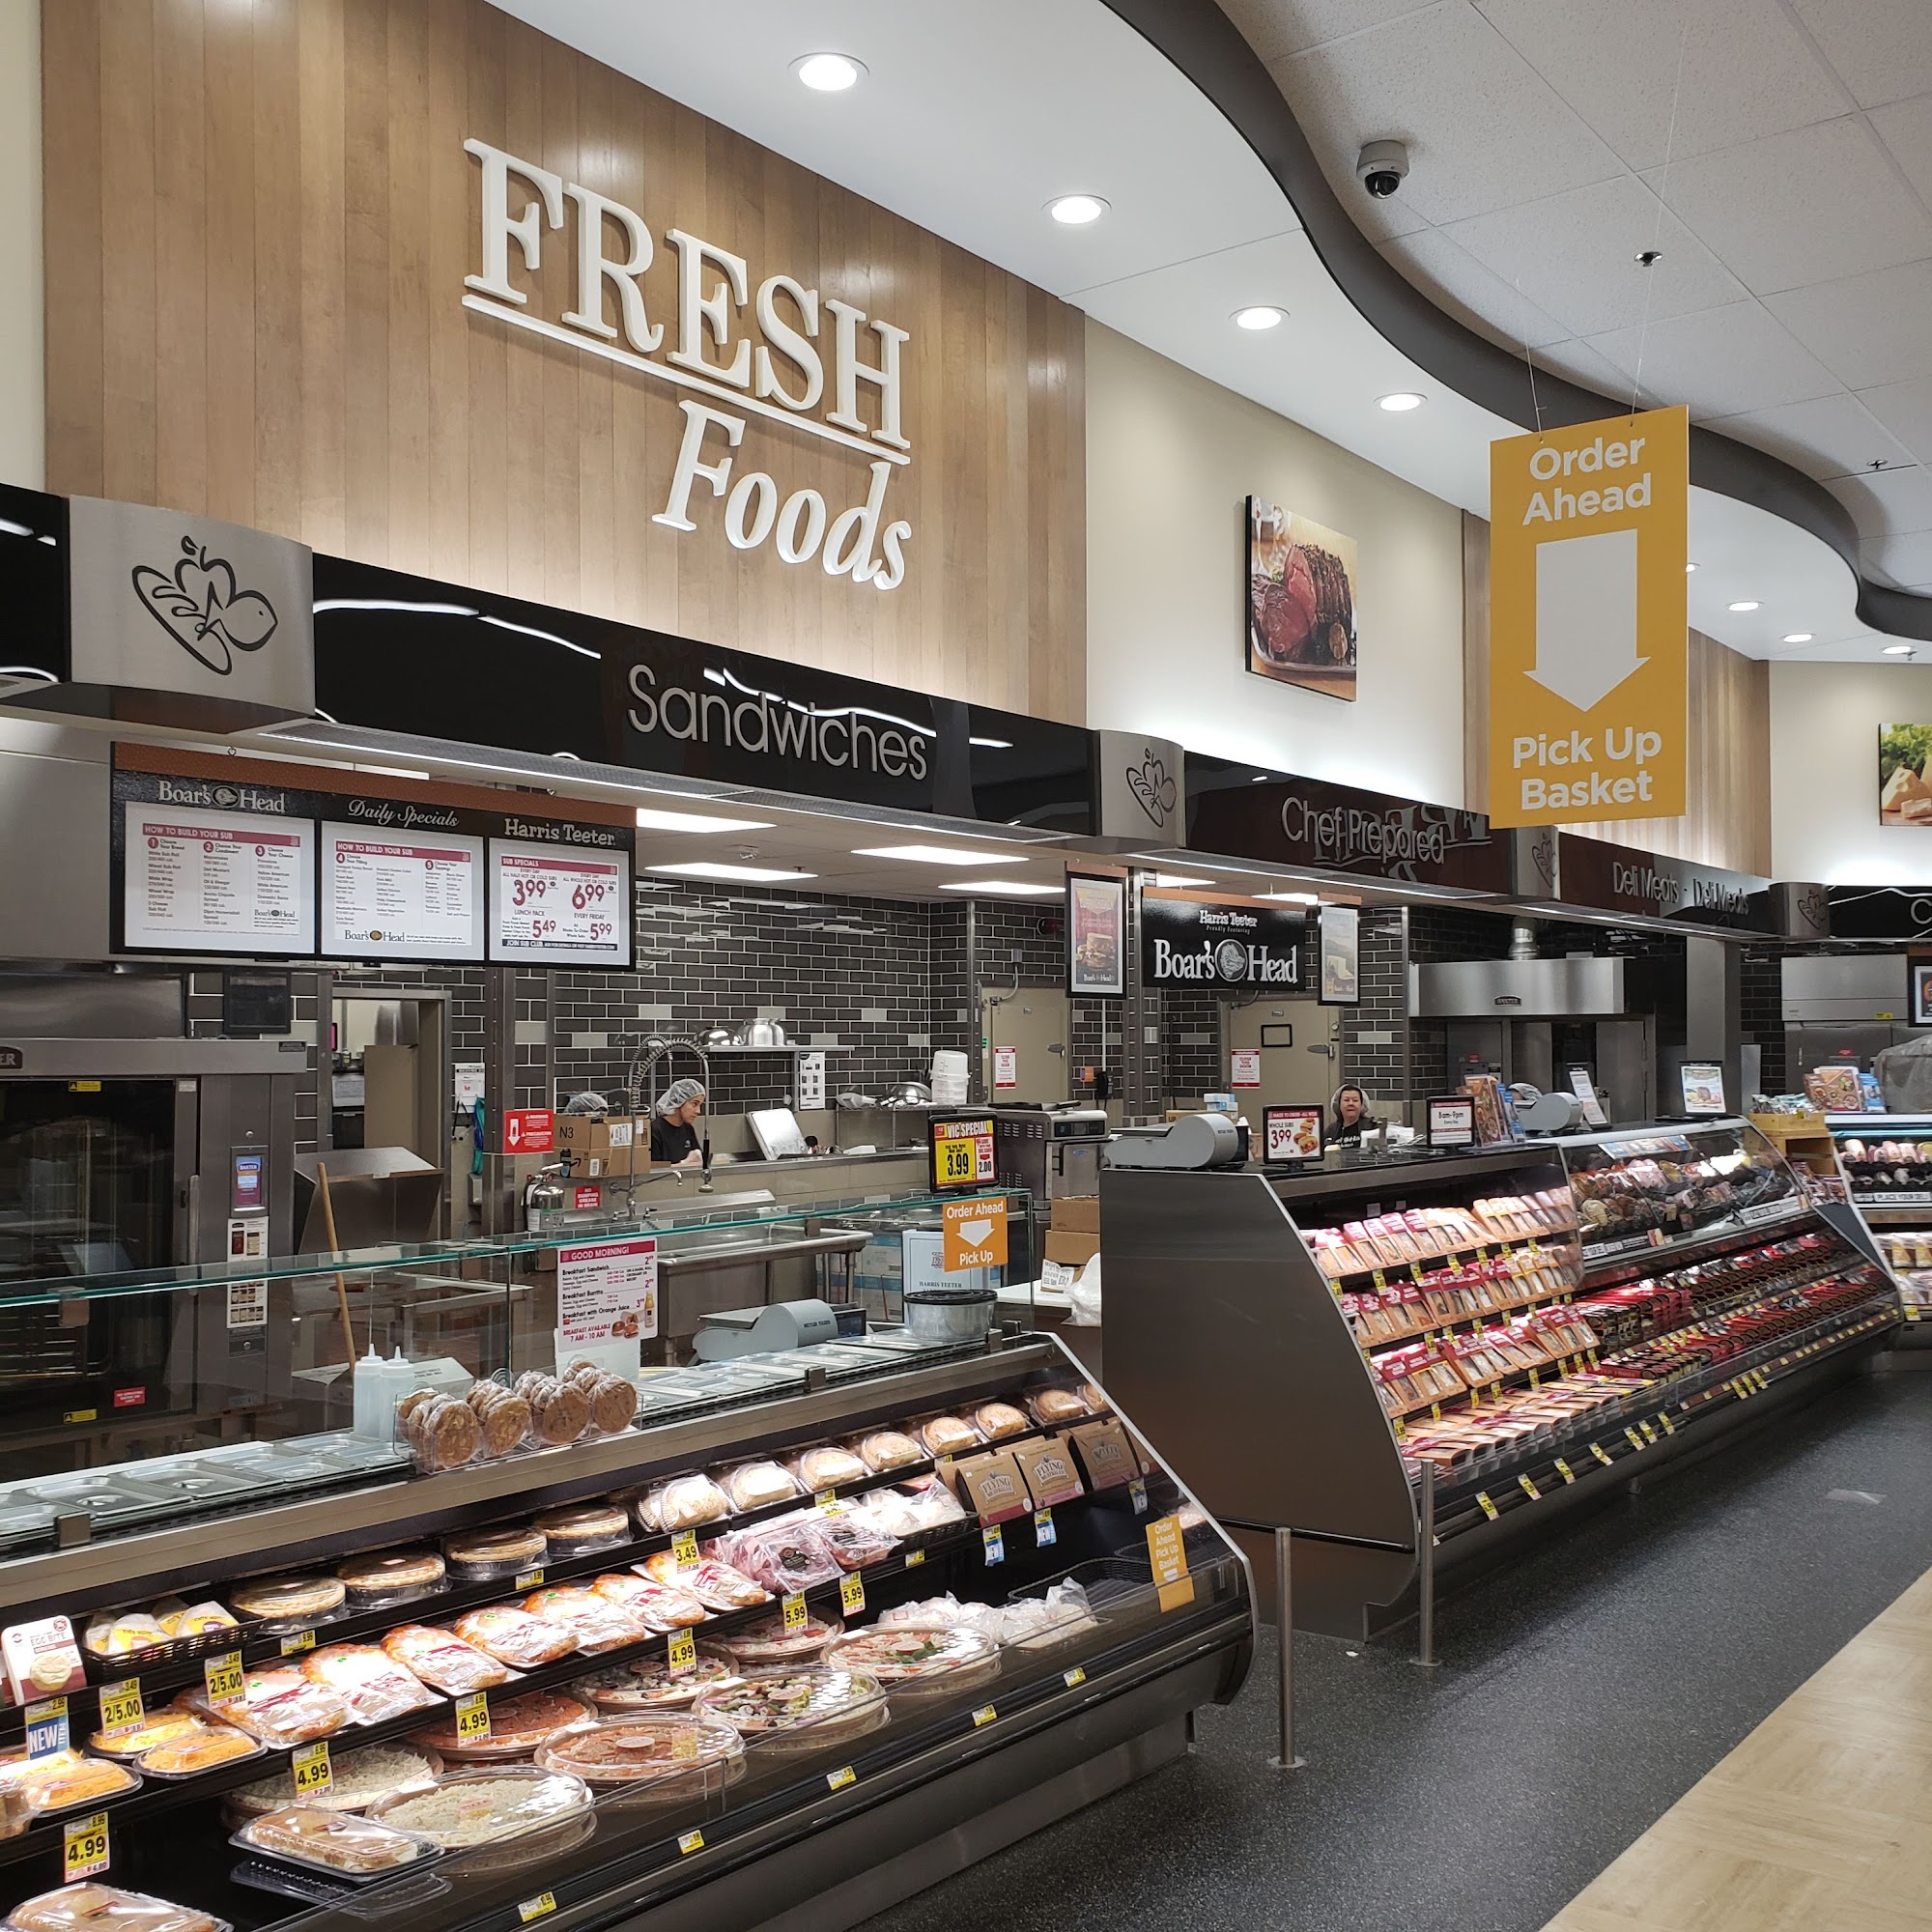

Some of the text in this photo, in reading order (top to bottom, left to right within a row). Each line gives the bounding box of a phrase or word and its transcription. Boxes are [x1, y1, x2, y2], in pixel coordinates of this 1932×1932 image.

[463, 137, 911, 450] FRESH
[1529, 436, 1646, 481] Order
[651, 399, 912, 591] Foods
[1522, 472, 1652, 526] Ahead
[628, 664, 927, 781] Sandwiches
[1513, 725, 1662, 769] Pick Up
[158, 780, 286, 814] Boar's Head
[1520, 770, 1653, 811] Basket
[348, 799, 460, 827] Daily Specials
[178, 828, 198, 837] BUILD
[200, 830, 218, 838] YOUR
[504, 818, 616, 846] Harris Teeter
[1282, 796, 1343, 847] Chef
[1349, 809, 1445, 864] Prepared
[514, 858, 539, 867] SPECIALS
[1612, 861, 1680, 904] Deli Meats
[1199, 910, 1258, 927] Harris Teeter
[345, 929, 369, 940] Boar's
[383, 930, 405, 942] Head
[1206, 924, 1251, 935] Proudly Featuring
[1153, 938, 1298, 983] Boar's Head
[560, 1126, 574, 1139] N3
[947, 1121, 987, 1138] VIC SPECIAL
[947, 1152, 969, 1177] 3.99
[979, 1161, 992, 1173] 2.00
[947, 1201, 1004, 1220] Order Ahead
[571, 1246, 630, 1261] GOOD MORNING!
[959, 1249, 994, 1265] Pick Up
[563, 1323, 611, 1336] BREAKFAST AVAILABLE
[575, 1333, 584, 1342] AM
[1037, 1461, 1064, 1477] FLYING
[981, 1477, 1010, 1492] FLYING
[1154, 1522, 1173, 1534] Order
[1156, 1531, 1176, 1547] Ahead
[675, 1546, 697, 1562] 3.49
[1155, 1544, 1179, 1560] Pick Up
[1159, 1555, 1179, 1571] Basket
[843, 1586, 863, 1603] 5.99
[785, 1605, 806, 1624] 5.99
[30, 1633, 67, 1646] EGG BITE
[227, 1652, 240, 1663] 3.49
[671, 1644, 694, 1663] 4.99
[124, 1679, 138, 1691] 3.49
[210, 1671, 242, 1694] 2/5.00
[52, 1697, 66, 1710] 2.99
[104, 1698, 141, 1723] 2/5.00
[460, 1711, 488, 1732] 4.99
[29, 1723, 58, 1753] NEW
[298, 1762, 328, 1786] 4.99
[69, 1835, 106, 1861] 4.99
